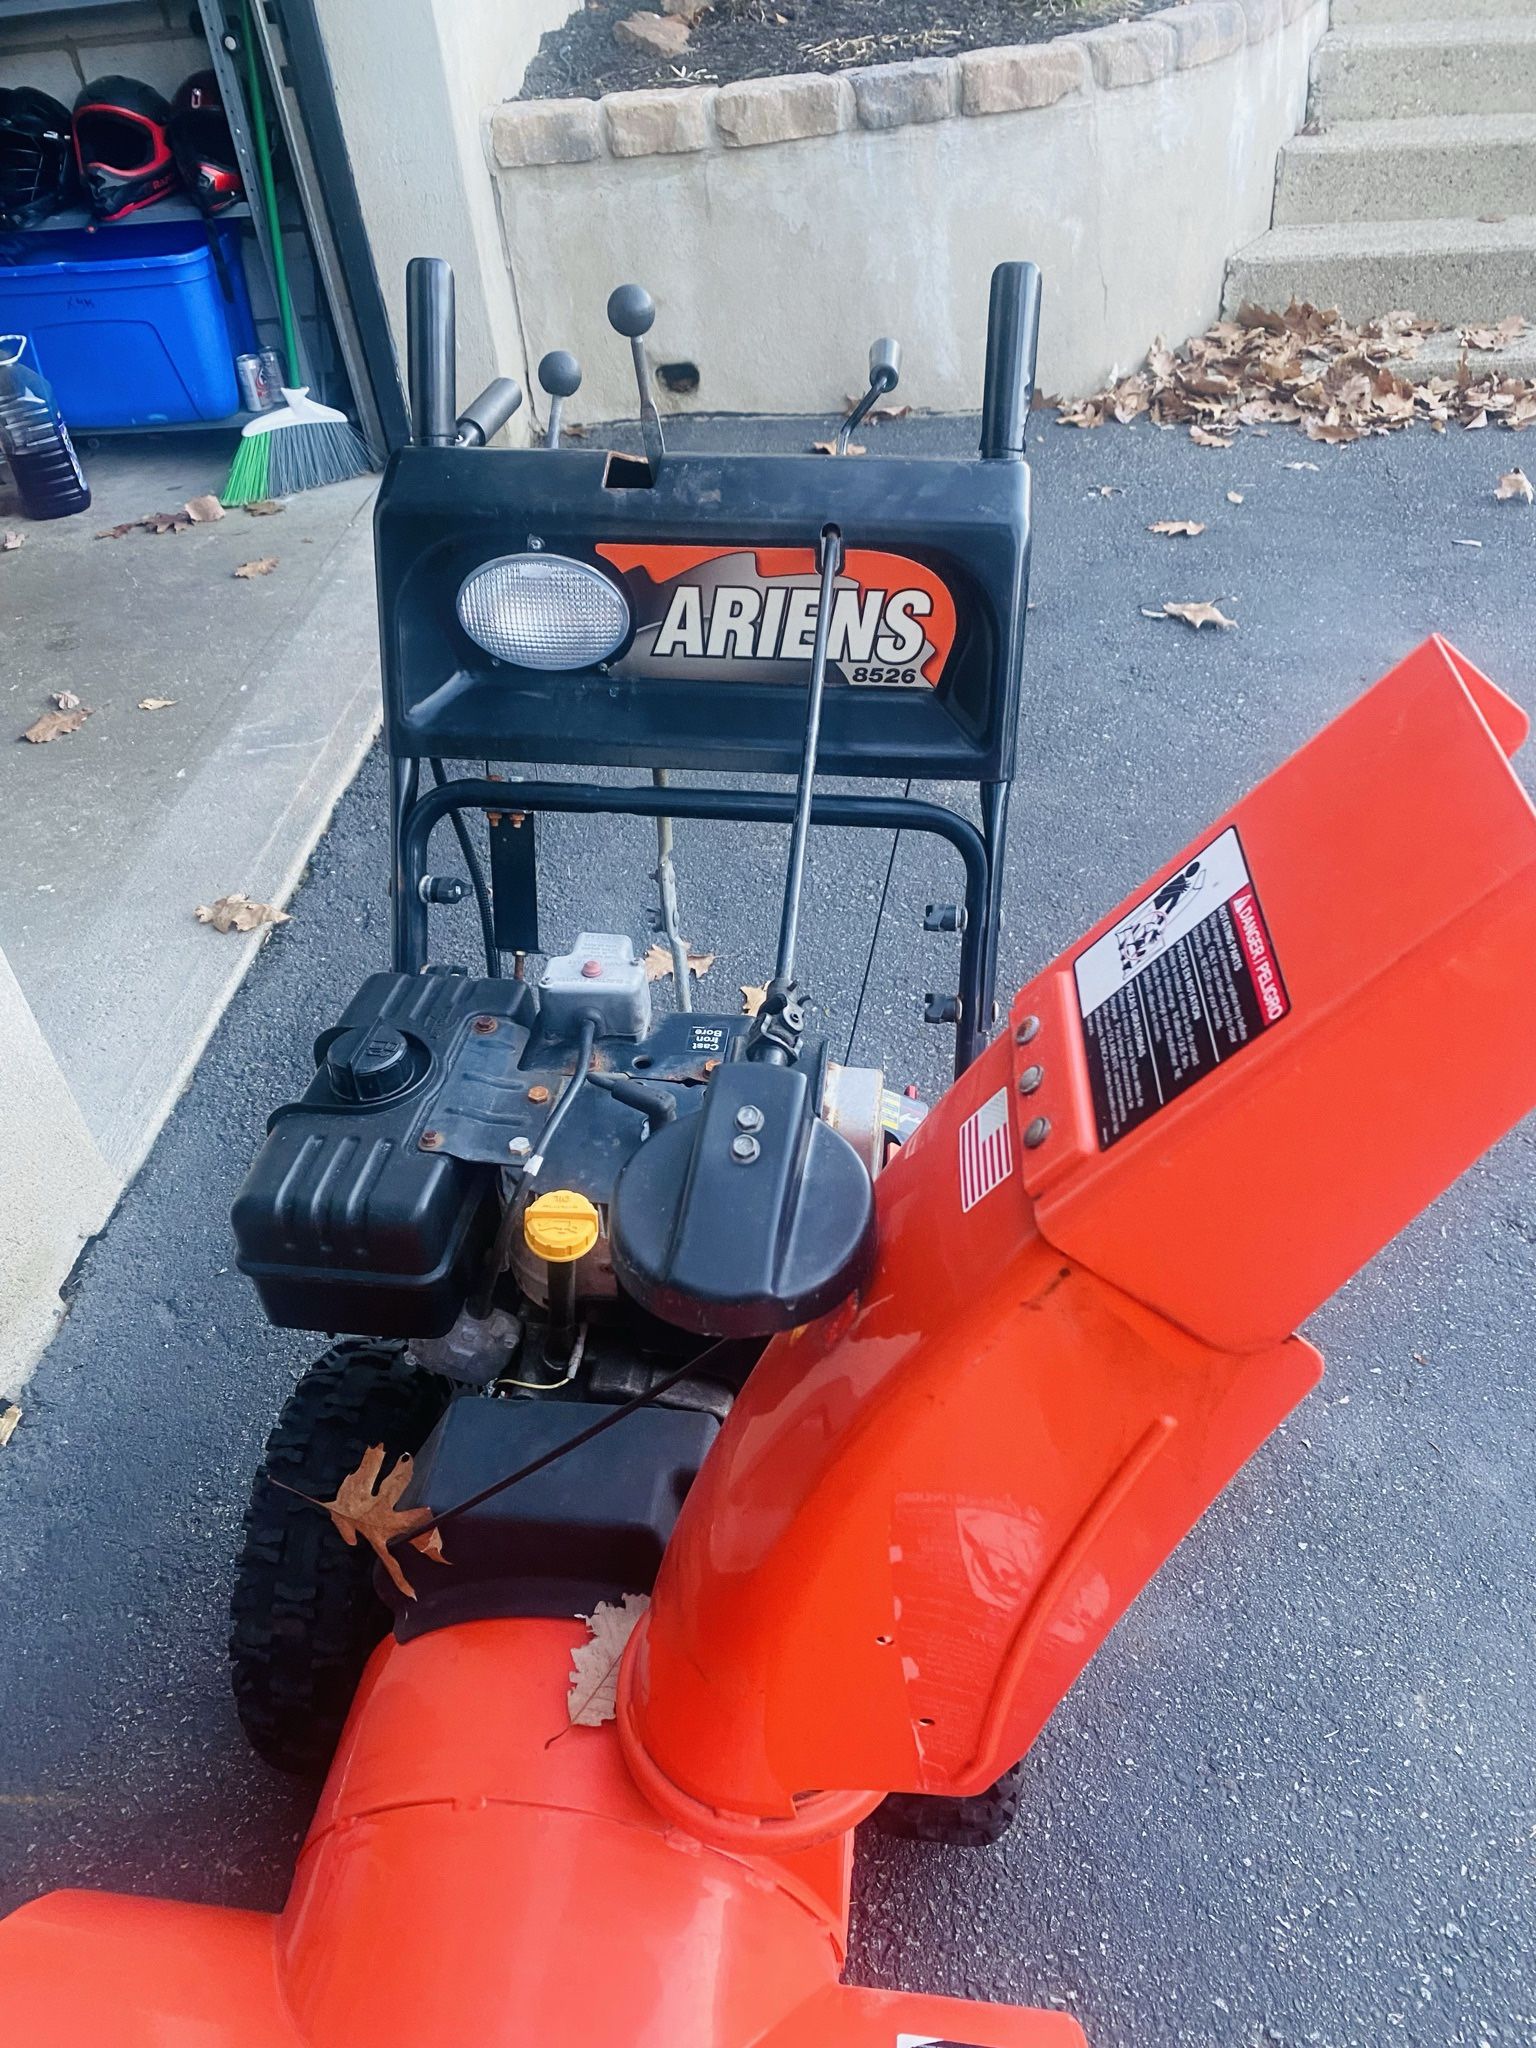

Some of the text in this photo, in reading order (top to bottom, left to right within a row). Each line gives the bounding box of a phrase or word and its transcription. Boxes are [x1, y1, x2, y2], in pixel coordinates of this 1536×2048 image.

[651, 585, 934, 664] ARIENS
[852, 668, 917, 683] 8526
[1217, 903, 1242, 973] ROTATING PARTS
[1238, 904, 1264, 961] DANGER
[1254, 959, 1283, 1022] PELIGRO
[1184, 976, 1201, 1022] ROTATION
[692, 1042, 719, 1051] Cast
[695, 1029, 722, 1037] Bore
